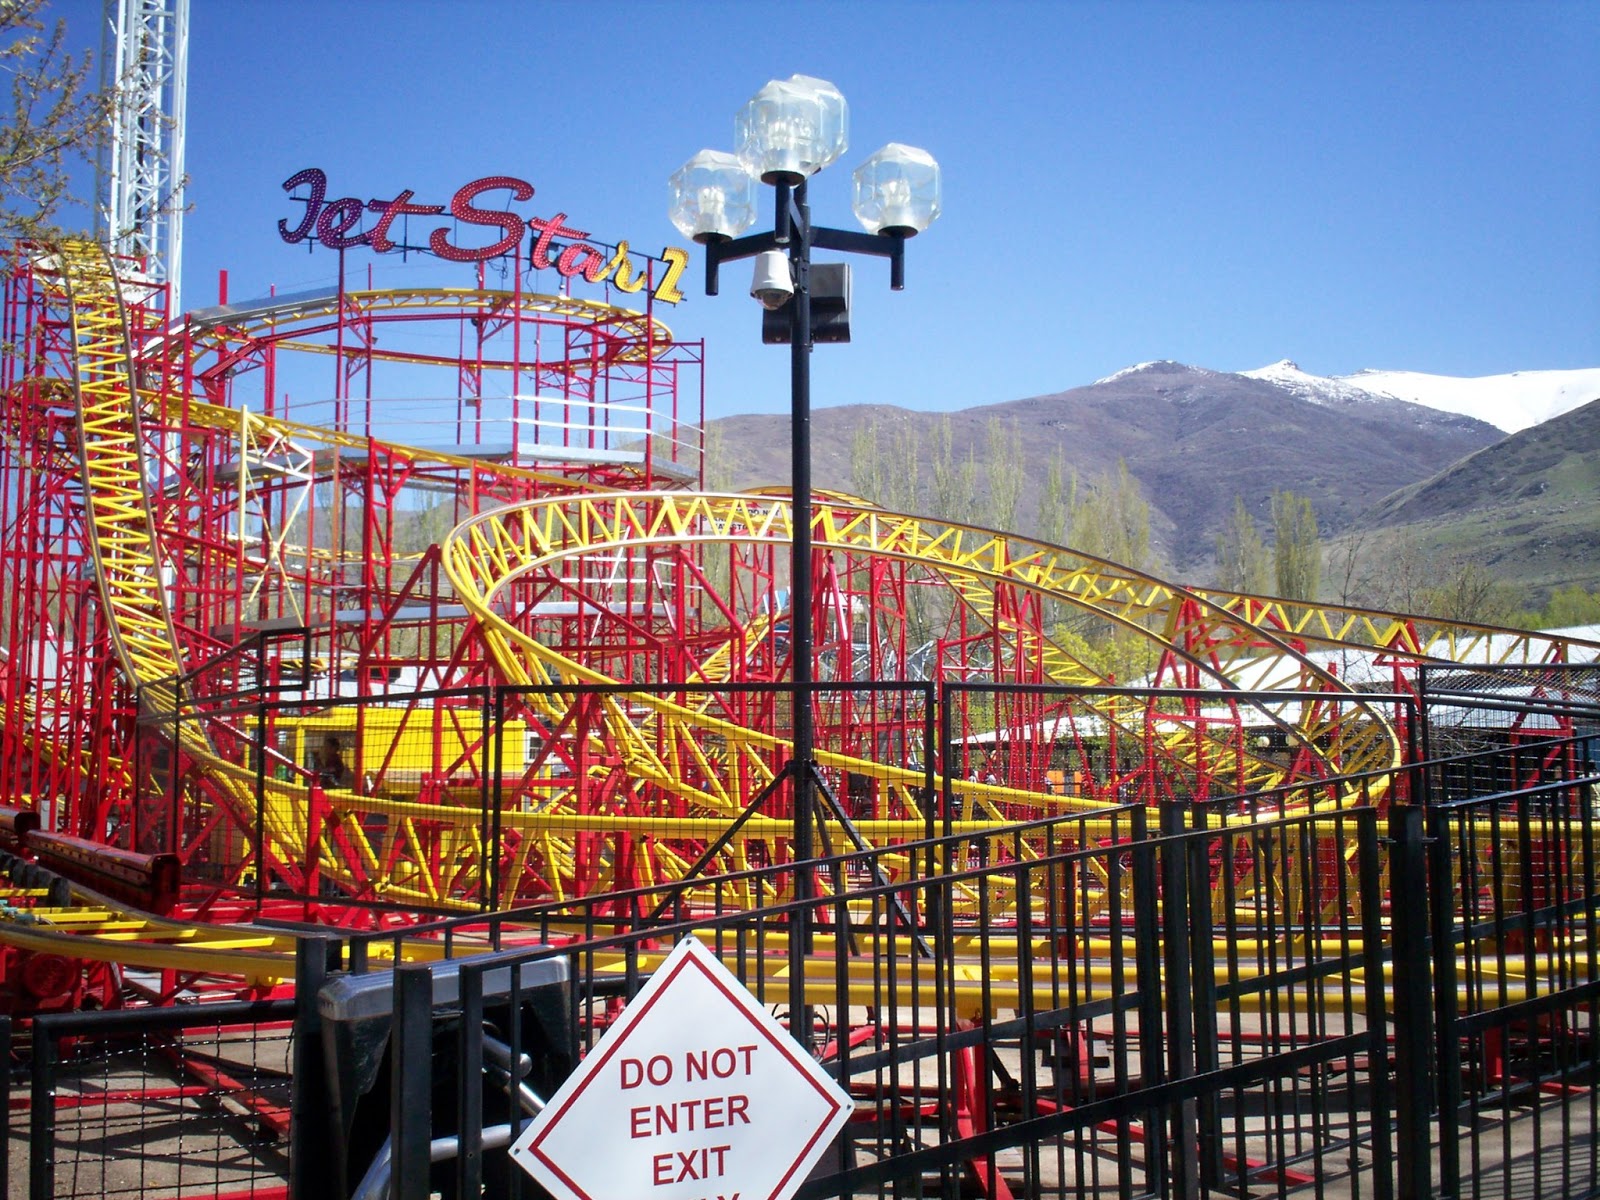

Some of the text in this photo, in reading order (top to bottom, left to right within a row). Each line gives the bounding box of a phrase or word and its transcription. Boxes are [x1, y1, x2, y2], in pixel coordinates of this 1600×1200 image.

[278, 167, 446, 253] Jet
[430, 175, 647, 294] Star
[620, 1044, 758, 1090] DO NOT
[630, 1094, 751, 1139] ENTER
[653, 1144, 731, 1186] EXIT
